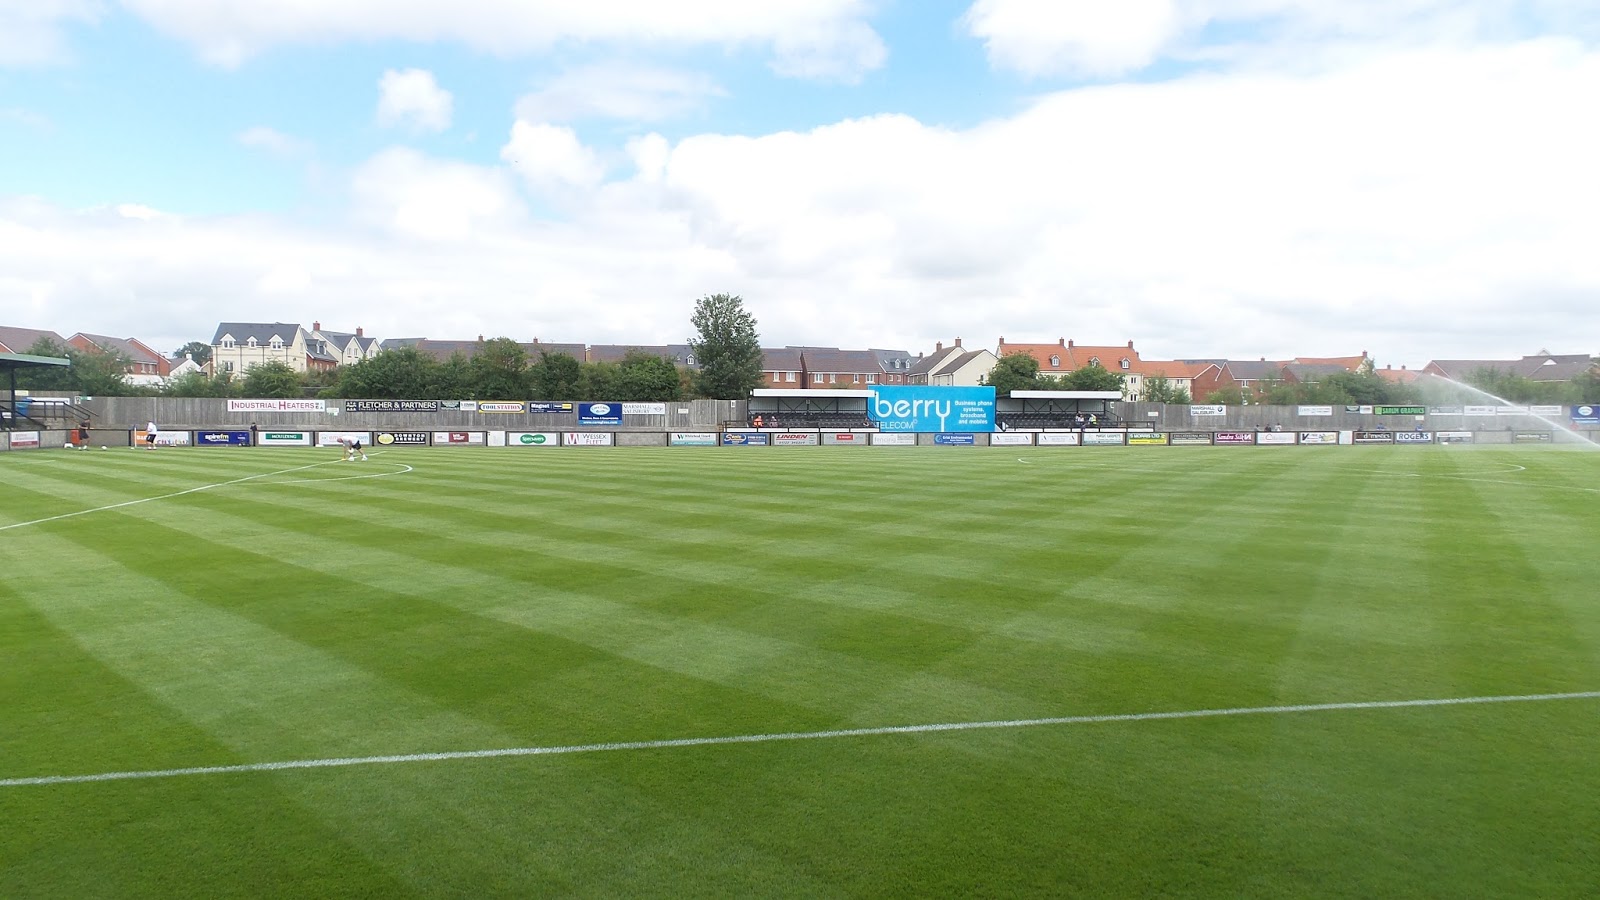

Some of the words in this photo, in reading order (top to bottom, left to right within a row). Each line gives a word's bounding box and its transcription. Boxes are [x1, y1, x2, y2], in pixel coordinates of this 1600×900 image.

[231, 401, 276, 410] INDUSTRIAL
[279, 401, 315, 410] HEATERS
[875, 391, 951, 432] berry
[874, 421, 914, 429] TELECOM
